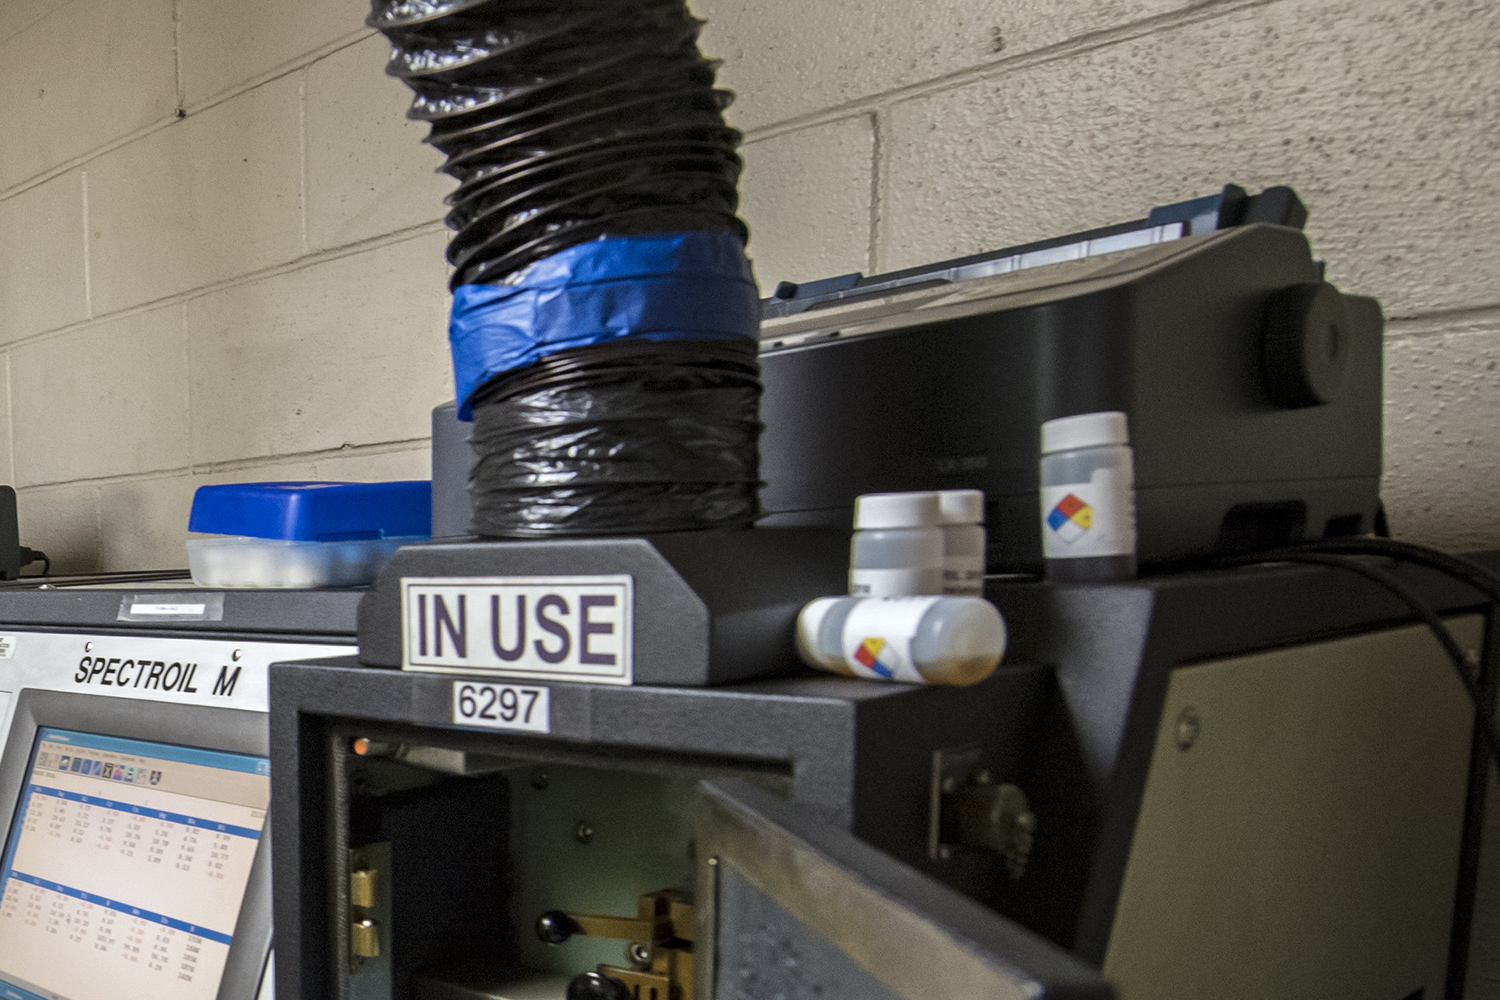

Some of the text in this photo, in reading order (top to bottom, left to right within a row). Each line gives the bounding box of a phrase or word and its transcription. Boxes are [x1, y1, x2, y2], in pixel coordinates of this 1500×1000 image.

[417, 593, 617, 666] IN USE
[74, 655, 243, 697] SPECTROIL M
[458, 684, 541, 724] 6297
